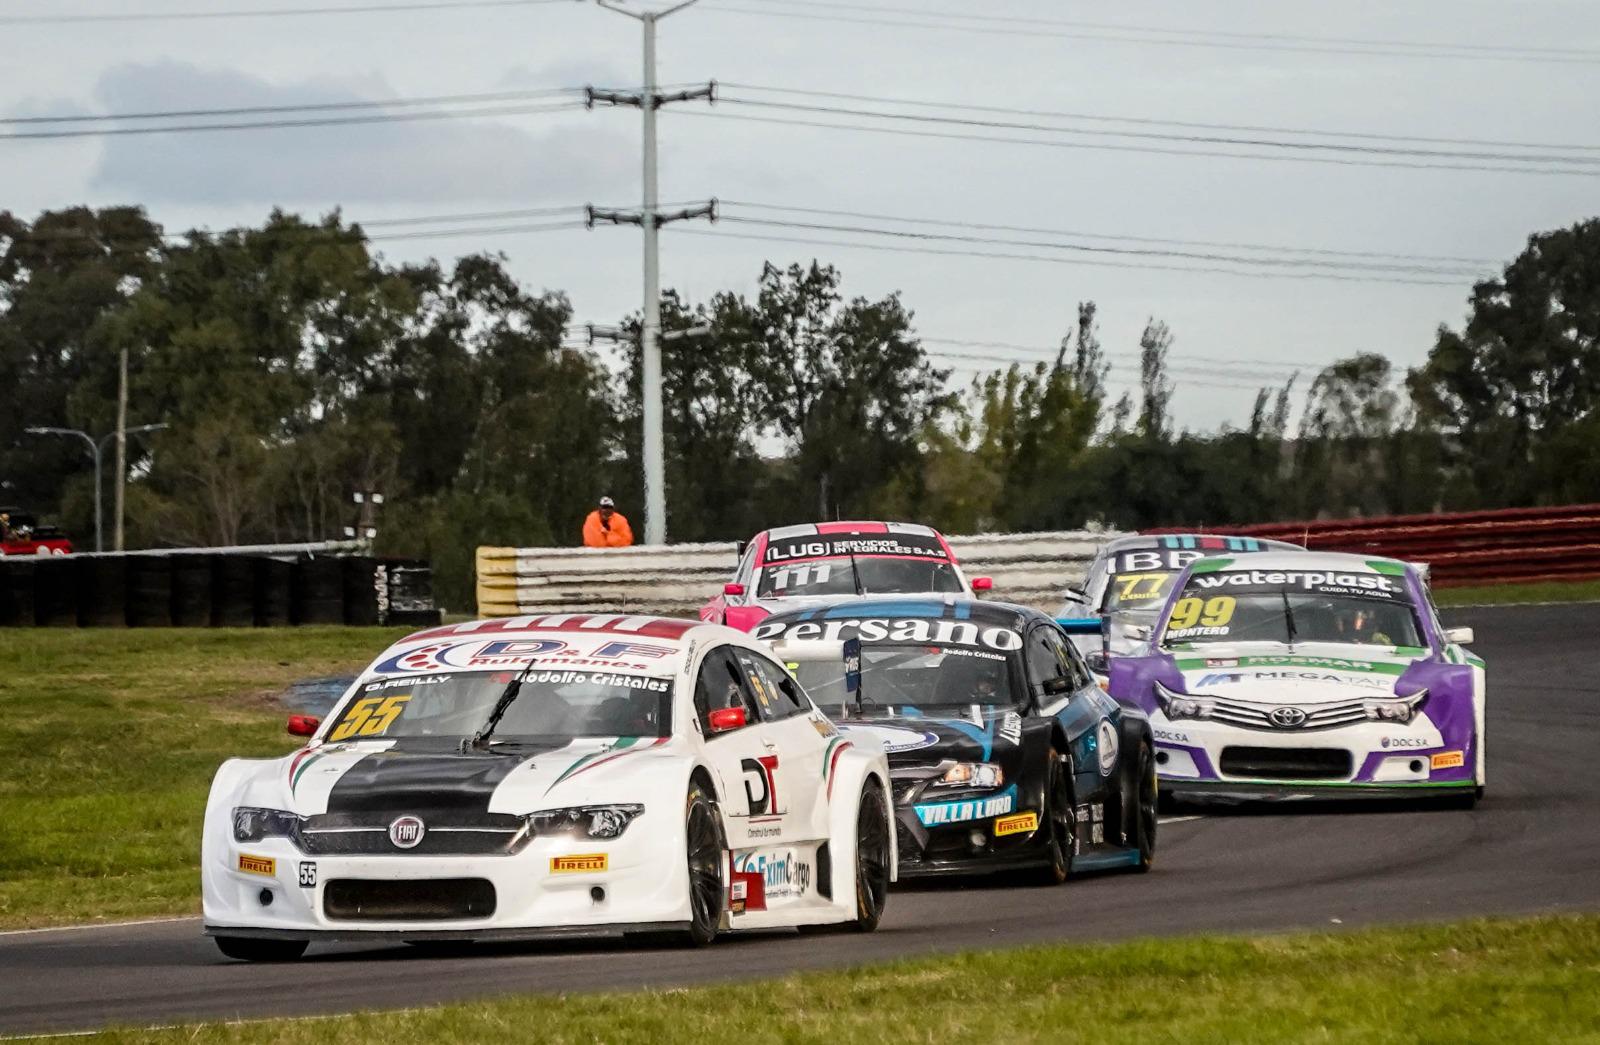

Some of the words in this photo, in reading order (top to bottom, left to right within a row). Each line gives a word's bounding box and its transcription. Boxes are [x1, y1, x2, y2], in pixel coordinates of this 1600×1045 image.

[833, 540, 898, 548] SERVICIOS
[834, 546, 912, 555] INEGRALES
[770, 564, 831, 590] 111
[1116, 573, 1169, 597] 77
[1196, 571, 1392, 591] waterplast
[1320, 586, 1348, 594] CUIDA
[1364, 590, 1392, 598] AGUA
[1169, 596, 1237, 630] 99
[1166, 626, 1230, 640] MONTERO
[468, 657, 648, 670] Rulemanes
[514, 671, 586, 684] Rodolfo
[590, 672, 669, 693] Cristales
[330, 695, 413, 742] 55
[1433, 753, 1461, 767] PIRELLI
[923, 801, 974, 825] VILLA
[975, 795, 1012, 820] LURO
[398, 825, 418, 840] FIAT
[998, 816, 1034, 833] PIRELLI
[239, 855, 273, 874] PIRELLI
[553, 855, 605, 870] PIRELLI
[300, 863, 317, 885] 55
